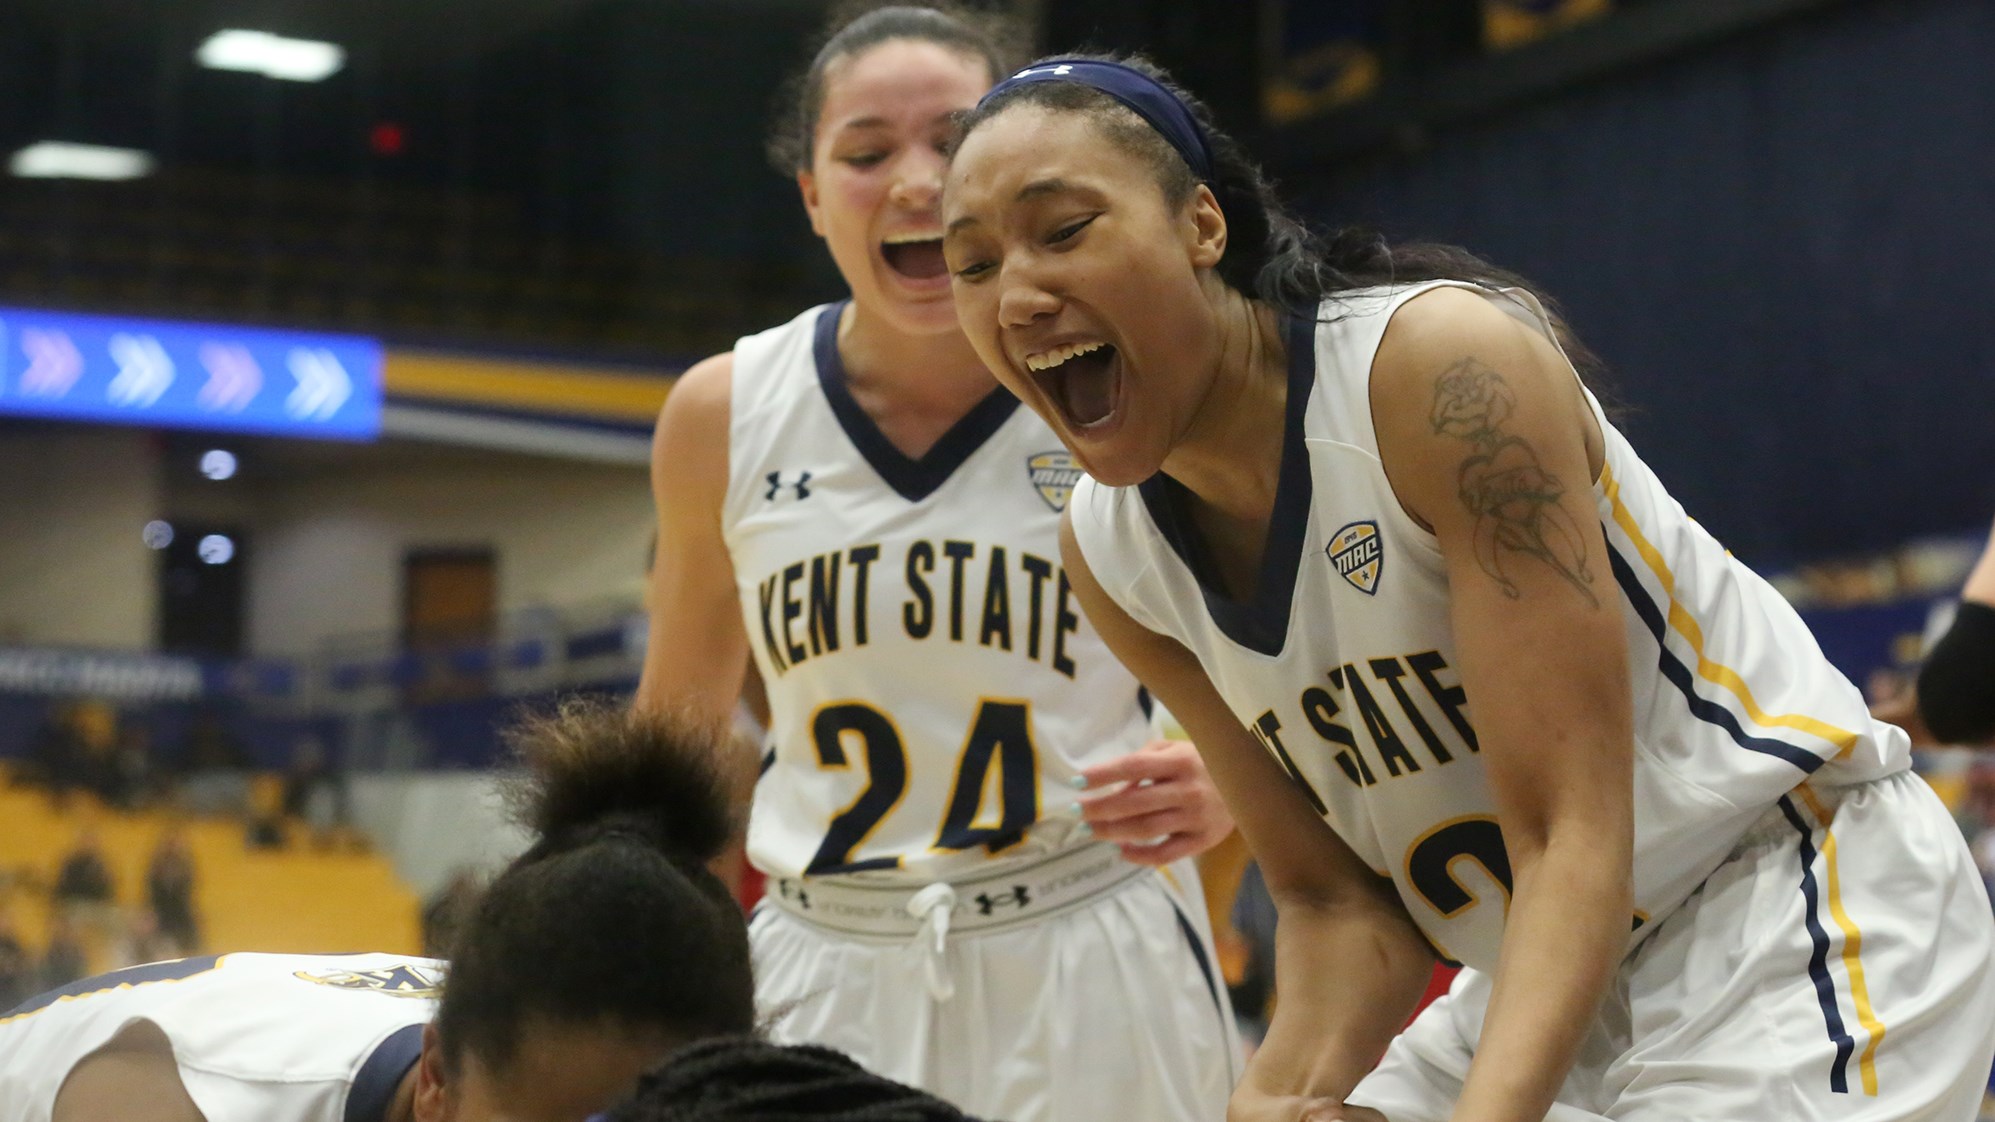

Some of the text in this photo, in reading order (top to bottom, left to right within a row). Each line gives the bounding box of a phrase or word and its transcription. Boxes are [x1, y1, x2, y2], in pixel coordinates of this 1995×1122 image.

[759, 540, 1081, 681] KENT STATE
[1335, 537, 1380, 574] MAC
[802, 696, 1043, 871] 24
